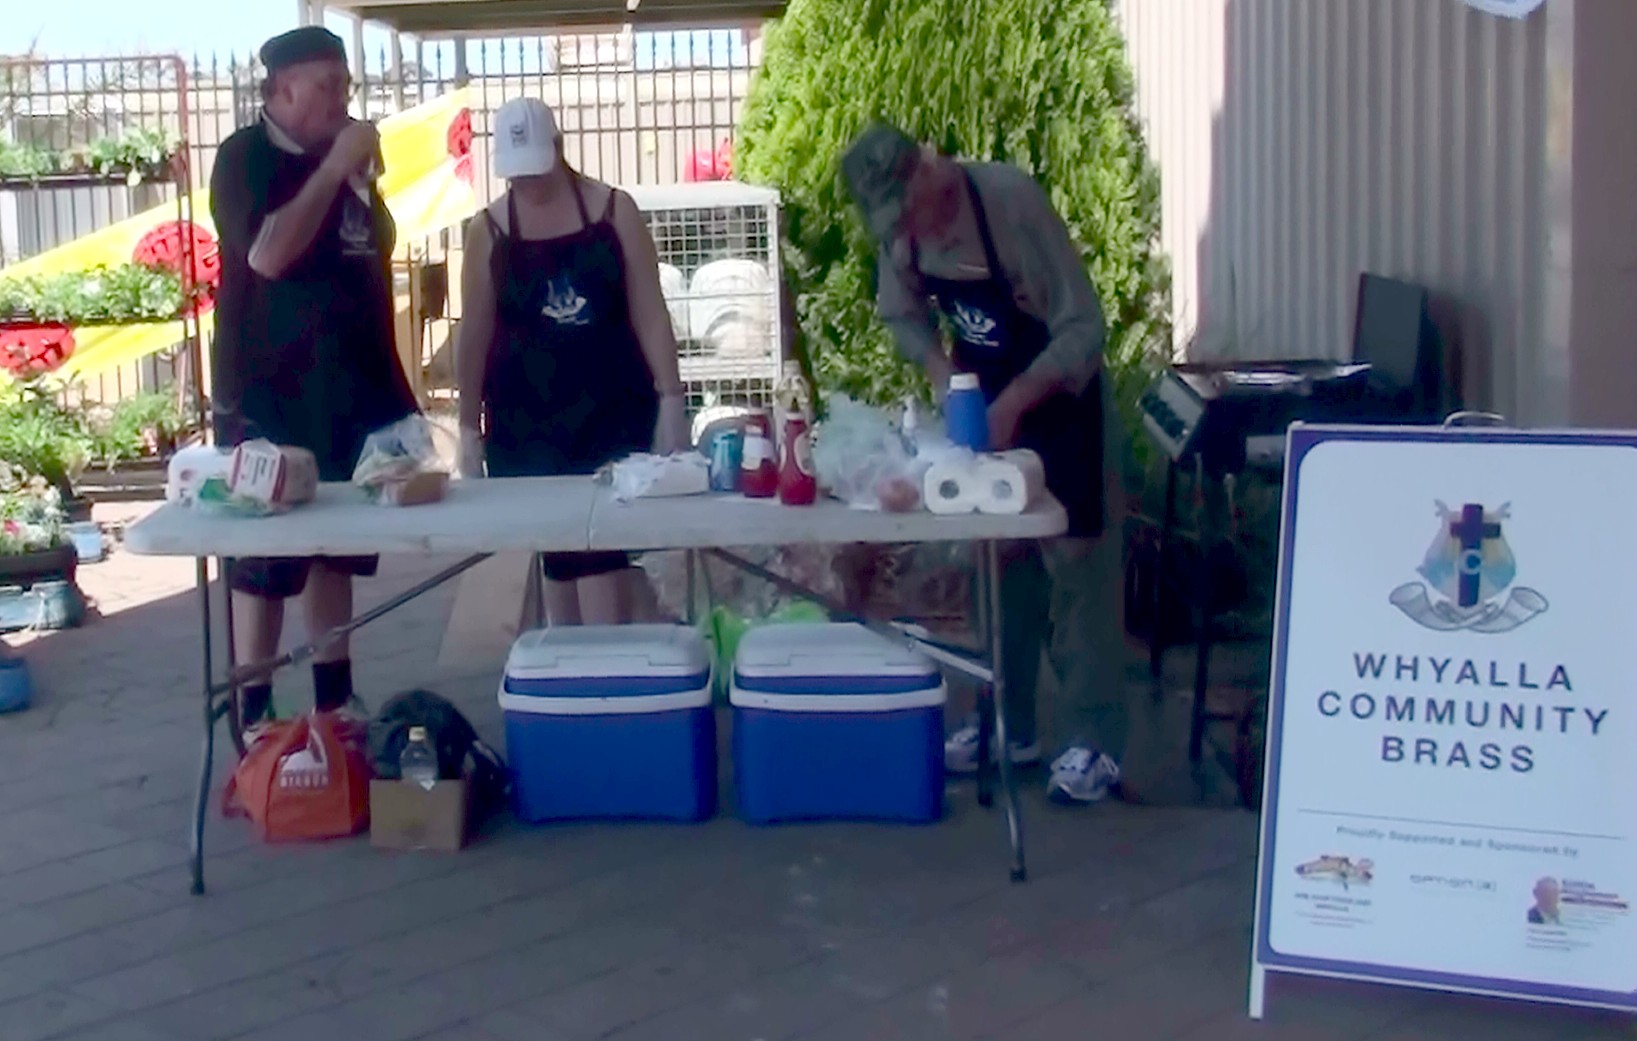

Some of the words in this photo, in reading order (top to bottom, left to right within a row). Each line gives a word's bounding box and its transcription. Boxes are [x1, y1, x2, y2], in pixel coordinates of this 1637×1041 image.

[1353, 652, 1573, 691] WHYALLA
[1317, 690, 1609, 735] COMMUNITY
[1380, 736, 1534, 773] BRASS
